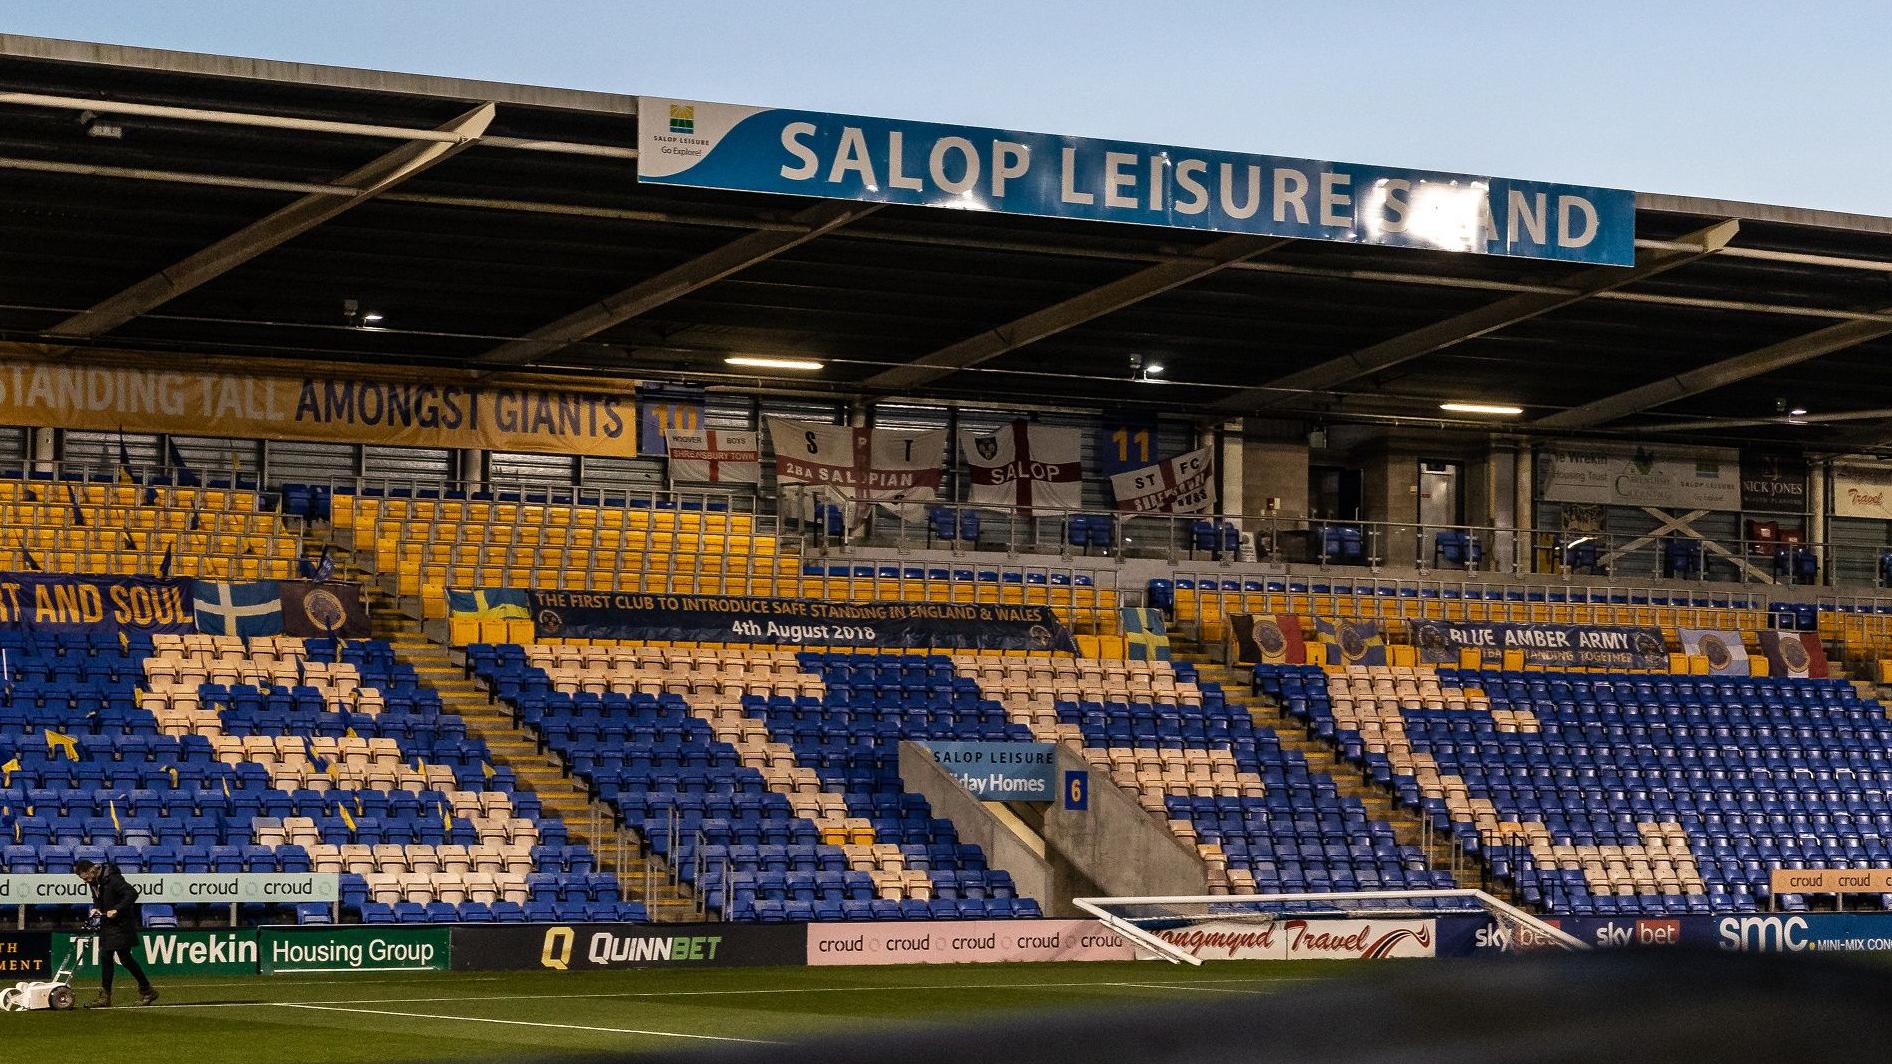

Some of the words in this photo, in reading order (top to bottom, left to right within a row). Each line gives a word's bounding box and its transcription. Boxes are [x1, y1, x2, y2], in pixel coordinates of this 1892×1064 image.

[653, 135, 678, 143] SALOP
[679, 138, 711, 146] LEISURE
[661, 146, 672, 154] Go
[780, 121, 1031, 199] SALOP
[1060, 147, 1352, 229] LEISURE
[199, 373, 285, 422] TALL
[295, 377, 485, 431] AMONGST
[493, 388, 625, 440] GIANTS
[651, 402, 698, 438] 10
[726, 437, 746, 445] BOYS
[804, 430, 819, 455] S
[904, 439, 914, 462] T
[1112, 427, 1150, 463] 11
[730, 452, 756, 461] TOWN
[991, 460, 1061, 485] SALOP
[1134, 473, 1156, 490] ST
[1179, 457, 1201, 475] FC
[1742, 480, 1770, 493] NICK
[1771, 481, 1803, 497] JONES
[35, 583, 104, 624] AND
[109, 584, 194, 626] SOUL
[536, 593, 567, 607] THE
[570, 595, 611, 609] FIRST
[615, 596, 654, 610] CLUB
[657, 598, 680, 611] TO
[682, 598, 770, 614] INTRODUCE
[773, 600, 807, 617] SAFE
[810, 604, 888, 620] STANDING
[889, 605, 905, 619] IN
[909, 605, 977, 621] ENGLAND
[980, 607, 992, 620] &
[995, 607, 1042, 622] WALES
[731, 619, 762, 636] 4th
[766, 620, 830, 643] August
[833, 625, 876, 640] 2018
[1448, 628, 1496, 646] BLUE
[1504, 629, 1571, 648] AMBER
[1579, 630, 1630, 650] ARMY
[933, 751, 983, 764] SALOP
[990, 752, 1054, 764] LEISURE
[989, 773, 1046, 793] Homes
[1070, 778, 1082, 802] 6
[188, 877, 239, 896] croud
[263, 877, 313, 896] croud
[1789, 872, 1823, 887] croud
[1838, 872, 1871, 887] croud
[818, 934, 864, 952] croud
[886, 933, 930, 951] croud
[952, 932, 996, 950] croud
[1016, 931, 1060, 949] croud
[1284, 919, 1371, 952] Travel
[1474, 922, 1513, 952] sky
[1595, 921, 1634, 946] sky
[1639, 922, 1677, 945] bet
[1718, 916, 1809, 953] smc
[1817, 938, 1865, 951] MINI-MIX
[1867, 938, 1892, 951] CON
[142, 934, 258, 965] Wrekin
[272, 940, 363, 967] Housing
[368, 938, 435, 965] Group
[588, 932, 722, 965] QUINNBET
